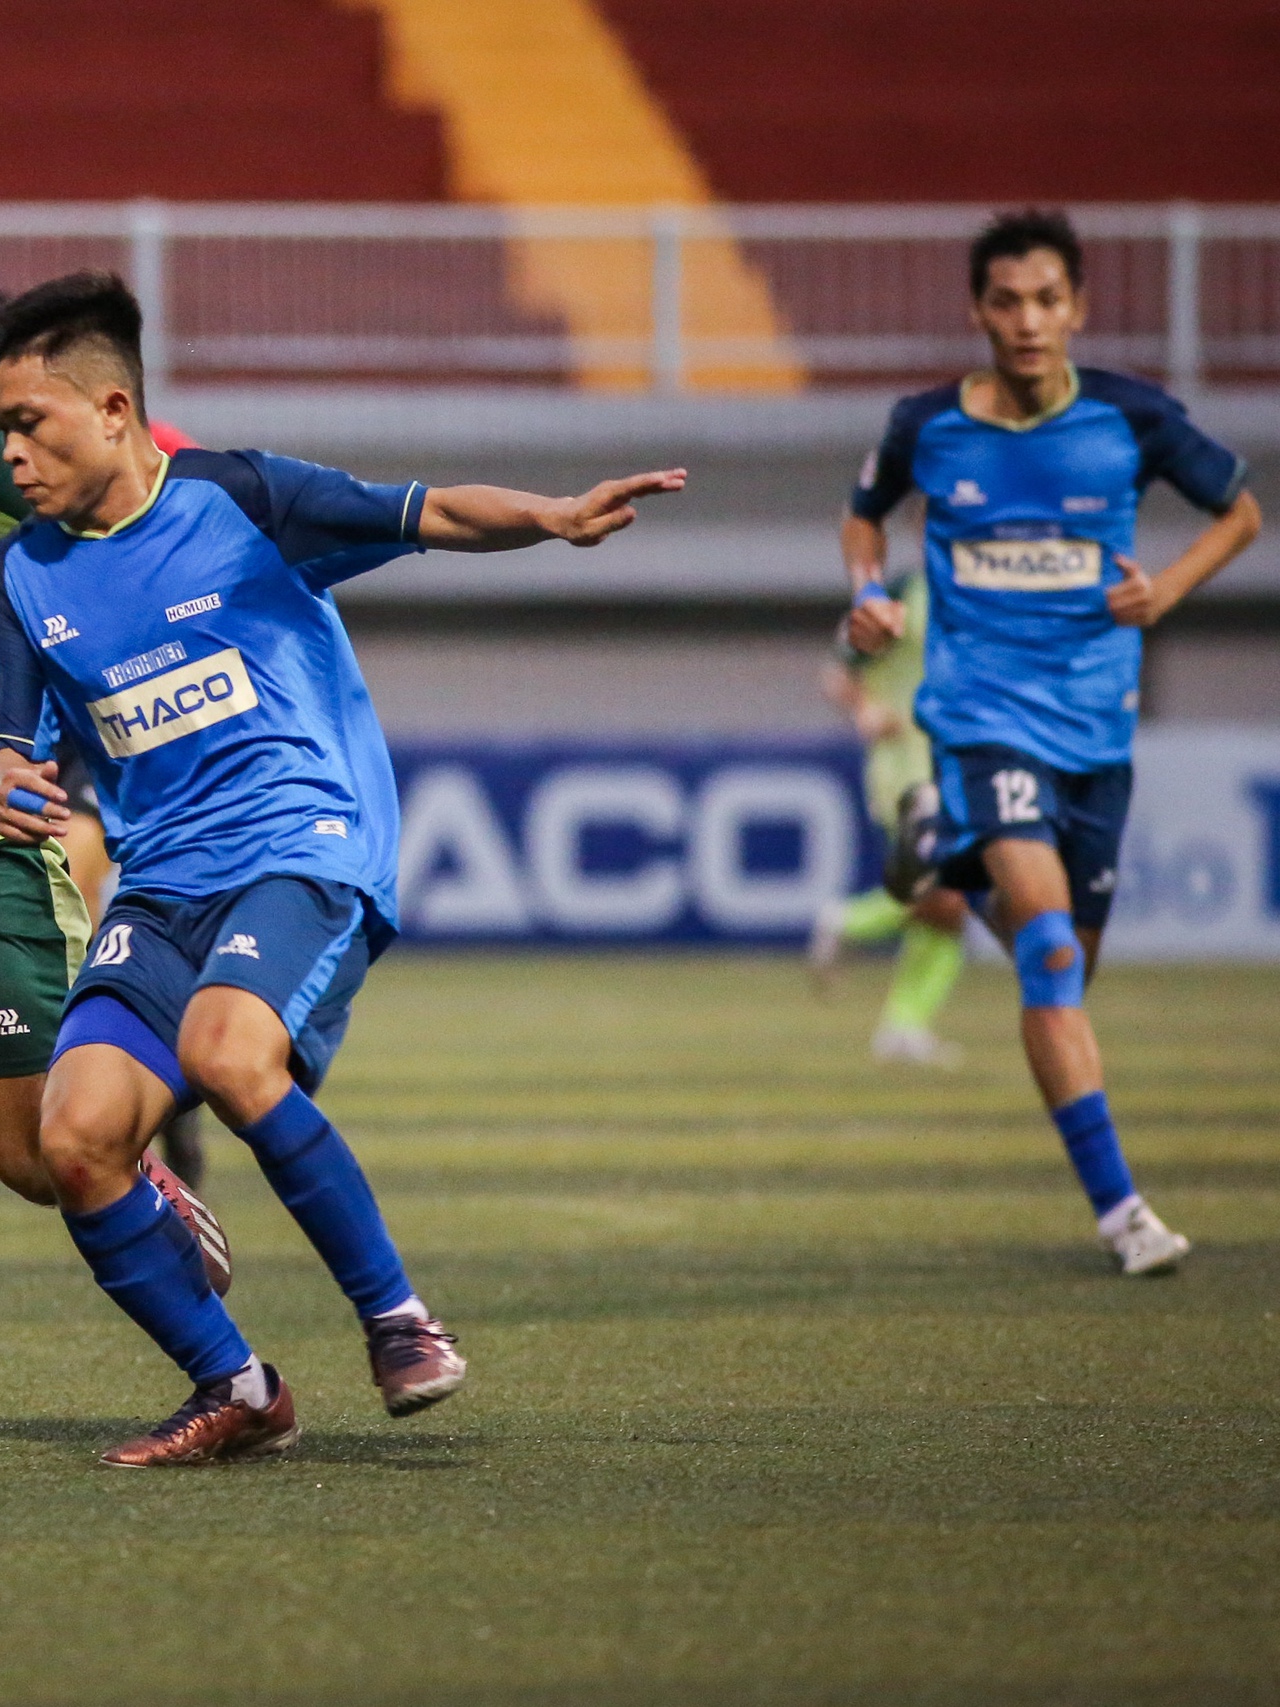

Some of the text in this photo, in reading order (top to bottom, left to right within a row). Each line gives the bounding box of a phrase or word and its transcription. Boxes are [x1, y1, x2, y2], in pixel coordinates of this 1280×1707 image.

[166, 594, 220, 621] HCMUTE
[101, 653, 153, 688] THANH
[101, 671, 234, 740] THACO
[991, 769, 1041, 822] 12
